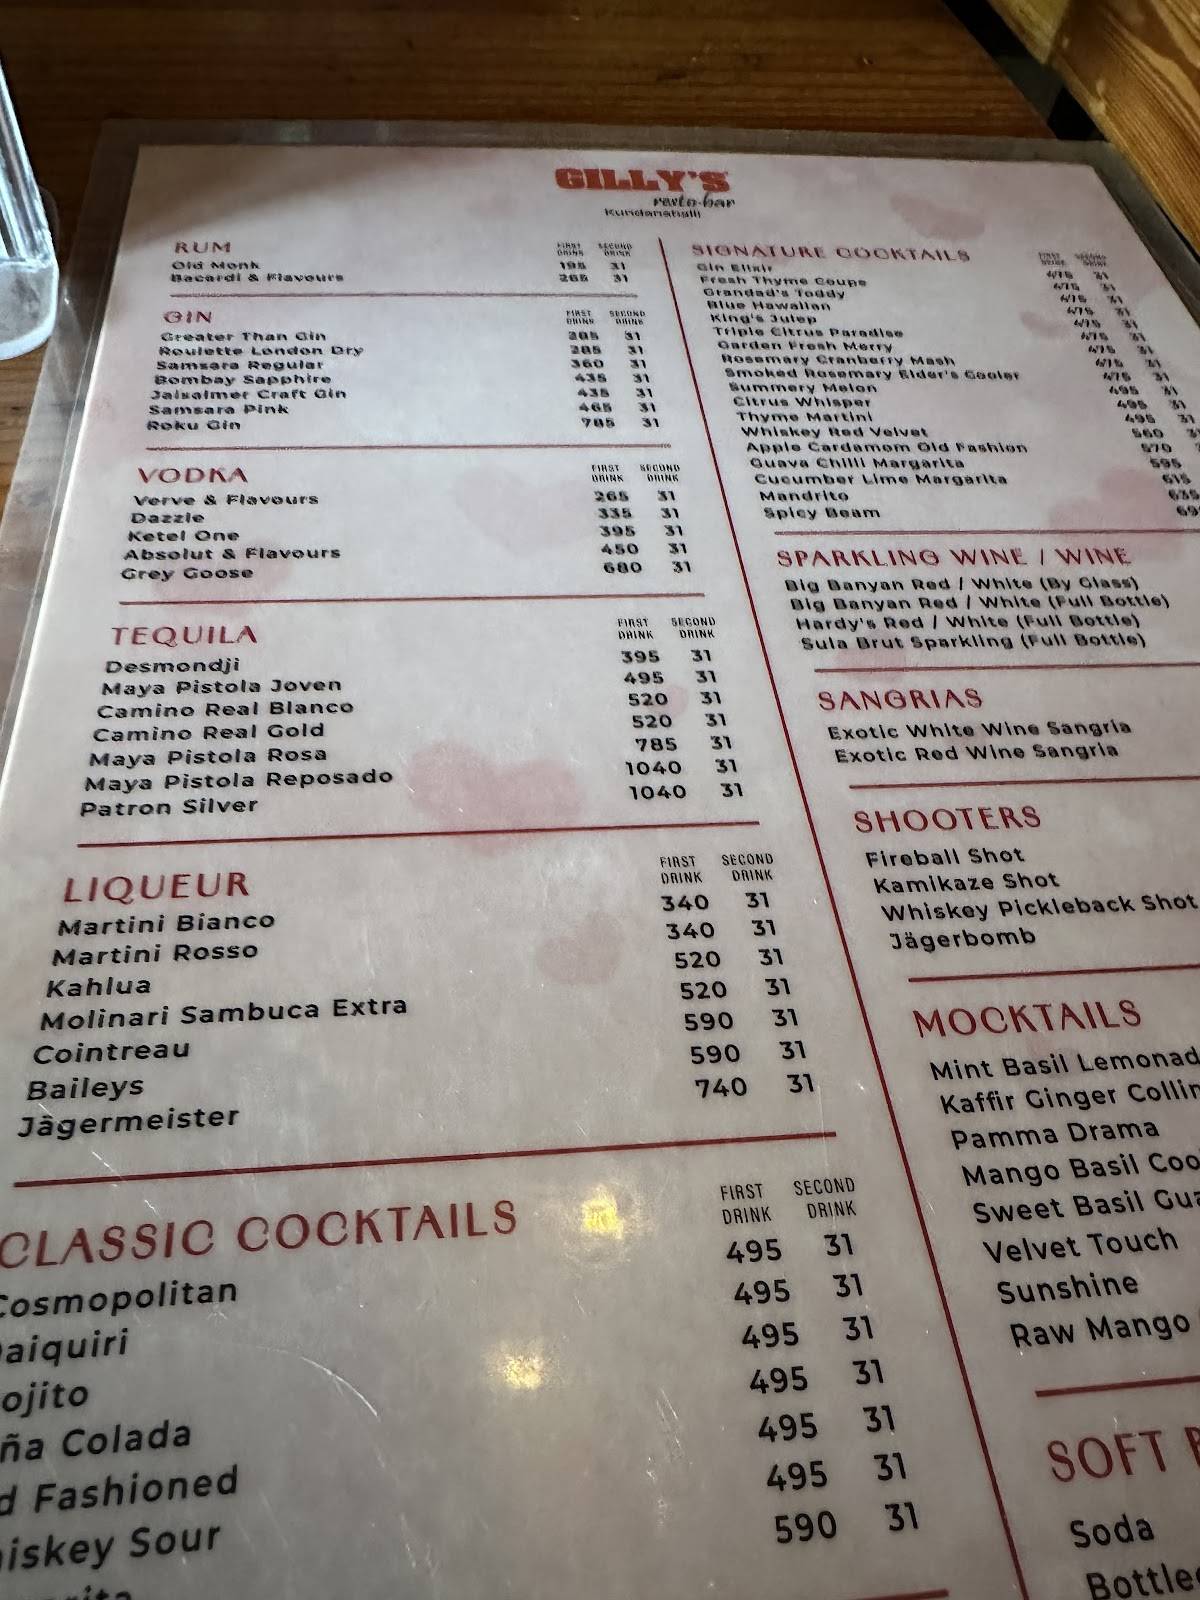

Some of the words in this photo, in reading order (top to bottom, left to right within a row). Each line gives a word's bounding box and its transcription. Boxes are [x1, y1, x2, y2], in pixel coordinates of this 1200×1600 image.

[555, 168, 730, 193] GILLY'S
[175, 242, 231, 253] RUM
[692, 245, 825, 258] SIGNATURE
[836, 247, 970, 262] COCKTAILS
[172, 261, 203, 270] Old
[210, 261, 260, 270] Monk
[171, 273, 241, 283] Bacardi
[248, 274, 259, 282] &
[266, 273, 344, 282] Flavours
[163, 311, 212, 324] GIN
[159, 346, 243, 356] Roulette
[251, 346, 323, 355] London
[331, 346, 363, 357] Dry
[154, 375, 235, 386] Bombay
[243, 373, 331, 385] Sapphire
[147, 420, 198, 431] Roku
[206, 420, 241, 430] Gin
[741, 426, 820, 439] Whiskey
[828, 427, 864, 437] Red
[869, 426, 928, 437] Velvet
[138, 467, 248, 484] VODKA
[754, 474, 854, 485] Cucumber
[862, 473, 908, 485] Lime
[915, 474, 1007, 486] Margarita
[133, 495, 195, 506] Verve
[204, 495, 217, 505] &
[226, 494, 318, 506] Flavours
[658, 490, 675, 501] 31
[759, 490, 849, 501] Mandrito
[131, 512, 205, 524] Dazzle
[764, 507, 816, 520] Spicy
[128, 530, 186, 542] Ketel
[194, 530, 240, 541] One
[123, 548, 213, 560] Absolut
[222, 548, 236, 560] &
[245, 547, 341, 559] Flavours
[777, 550, 939, 567] SPARKLING
[949, 548, 1027, 566] WINE
[1054, 547, 1131, 565] WINE
[120, 568, 174, 582] Grey
[183, 567, 253, 579] Goose
[785, 579, 819, 594] Big
[827, 579, 904, 593] Banyan
[911, 578, 951, 590] Red
[971, 577, 1032, 590] White
[1079, 576, 1139, 591] Glass)
[617, 618, 648, 628] FIRST
[671, 617, 715, 627] SECOND
[111, 625, 257, 648] TEQUILA
[618, 630, 653, 640] DRINK
[679, 629, 715, 638] DRINK
[801, 637, 848, 650] Sula
[856, 637, 904, 649] Brut
[910, 634, 1013, 651] Sparkling
[1074, 632, 1146, 648] Bottle)
[105, 657, 239, 675] Desmondji
[621, 650, 660, 664] 395
[691, 649, 711, 662] 31
[102, 683, 165, 698] Maya
[176, 679, 261, 694] Pistola
[271, 679, 341, 692] Joven
[97, 703, 195, 719] Camino
[205, 701, 258, 717] Real
[270, 701, 354, 715] Blanco
[818, 688, 983, 711] SANGRIAS
[828, 724, 899, 740] Exotic
[906, 723, 974, 738] White
[981, 721, 1040, 736] Wine
[1047, 719, 1132, 737] Sangria
[835, 747, 907, 763] Exotic
[915, 745, 958, 761] Red
[965, 744, 1025, 760] Wine
[1032, 742, 1119, 760] Sangria
[85, 777, 152, 794] Maya
[164, 773, 254, 789] Pistola
[266, 768, 393, 789] Reposado
[629, 785, 687, 800] 1040
[720, 783, 743, 797] 31
[80, 802, 171, 817] Patron
[183, 798, 258, 814] Silver
[854, 806, 1041, 833] SHOOTERS
[865, 848, 960, 868] Fireball
[968, 848, 1025, 864] Shot
[64, 872, 249, 905] LIQUEUR
[873, 875, 994, 894] Kamikaze
[1002, 872, 1060, 889] Shot
[661, 894, 709, 912] 340
[745, 892, 769, 908] 31
[881, 902, 987, 922] Whiskey
[998, 896, 1136, 917] Pickleback
[1141, 894, 1198, 911] Shot
[58, 914, 165, 936] Martini
[176, 913, 275, 932] Bianco
[889, 927, 1036, 954] Jägerbomb
[52, 944, 161, 967] Martini
[173, 944, 258, 962] Rosso
[46, 977, 151, 998] Kahlua
[40, 1005, 169, 1031] Molinari
[180, 1002, 319, 1024] Sambuca
[333, 998, 407, 1017] Extra
[912, 1000, 1141, 1038] MOCKTAILS
[33, 1043, 189, 1065] Cointreau
[929, 1059, 994, 1080] Mint
[1002, 1053, 1069, 1076] Basil
[1077, 1046, 1200, 1072] Lemonad
[26, 1077, 144, 1101] Baileys
[695, 1077, 747, 1099] 740
[787, 1073, 814, 1093] 31
[940, 1090, 1014, 1114] Kaffir
[1025, 1087, 1116, 1111] Ginger
[17, 1107, 240, 1141] Jägermeister
[951, 1128, 1059, 1150] Pamma
[1067, 1122, 1160, 1142] Drama
[961, 1164, 1060, 1187] Mango
[1068, 1153, 1139, 1179] Basil
[720, 1183, 762, 1201] FIRST
[793, 1177, 855, 1196] SECOND
[722, 1206, 772, 1225] DRINK
[807, 1200, 857, 1219] DRINK
[0, 1220, 214, 1269] CLASSIC
[237, 1200, 517, 1252] COCKTAILS
[726, 1238, 782, 1264] 495
[824, 1233, 853, 1256] 31
[982, 1237, 1081, 1264] Velvet
[1089, 1227, 1178, 1256] Touch
[997, 1272, 1138, 1305] Sunshine
[1010, 1323, 1074, 1348] Raw
[1085, 1314, 1190, 1341] Mango
[0, 1328, 128, 1367] aiquiri
[62, 1419, 191, 1457] Colada
[1047, 1430, 1166, 1483] SOFT
[34, 1464, 238, 1513] Fashioned
[774, 1510, 837, 1544] 590
[885, 1501, 919, 1532] 31
[1070, 1513, 1155, 1548] Soda
[129, 1526, 221, 1558] Sour
